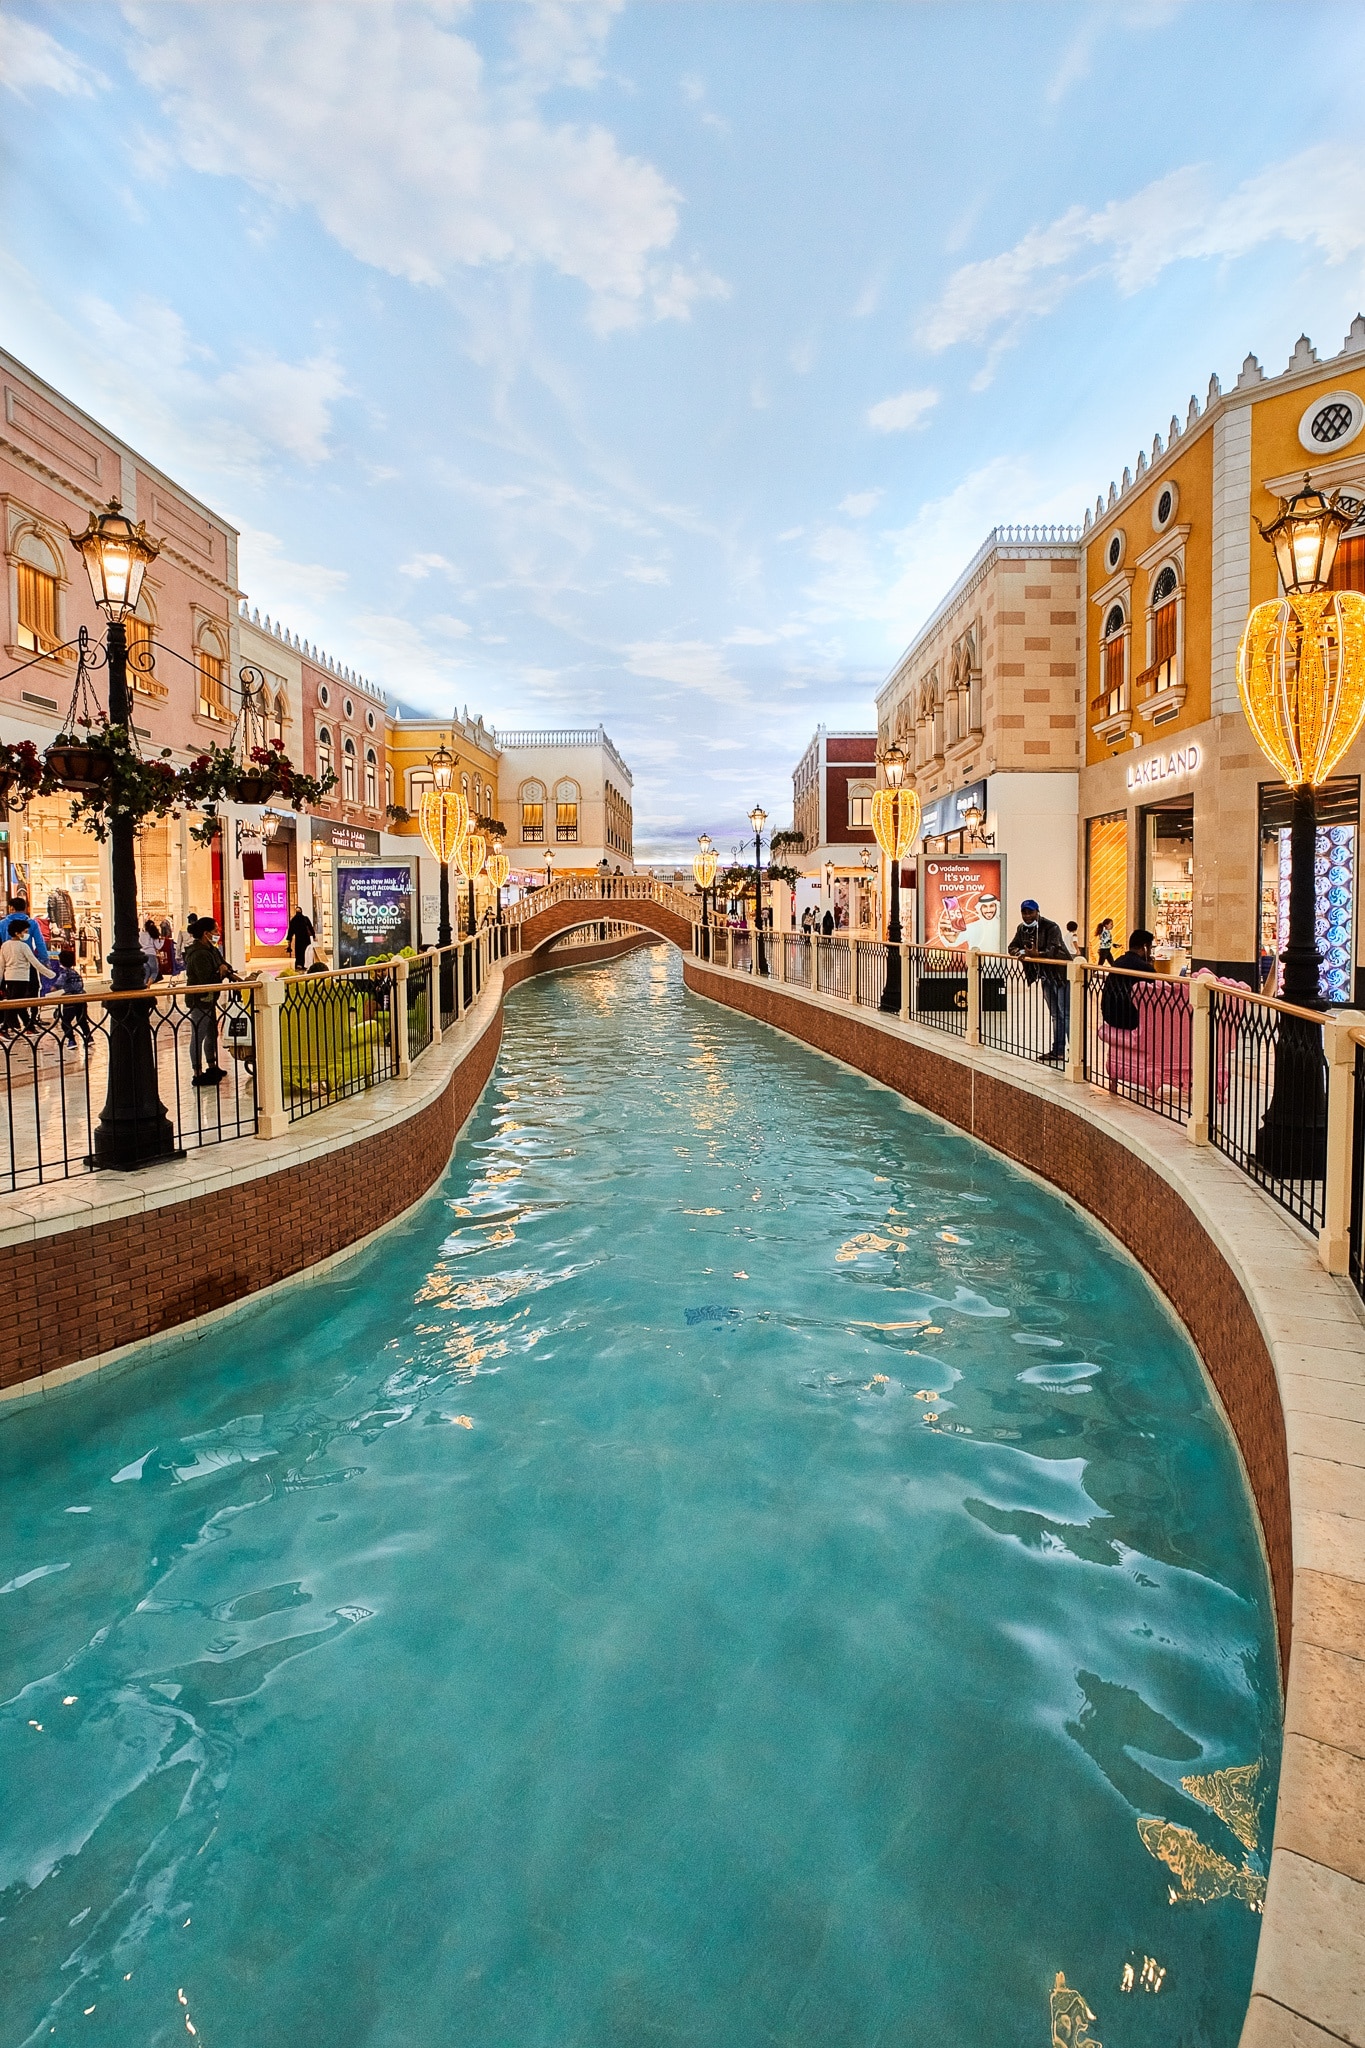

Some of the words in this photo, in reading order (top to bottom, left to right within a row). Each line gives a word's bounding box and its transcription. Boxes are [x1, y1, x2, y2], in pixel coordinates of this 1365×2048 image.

[1126, 746, 1200, 789] LAKELAND
[332, 837, 349, 847] CHARLES
[350, 840, 354, 848] &
[351, 878, 366, 886] Open
[944, 873, 959, 882] It's
[959, 874, 981, 884] your
[356, 884, 377, 892] Deposit
[939, 884, 966, 892] move
[966, 884, 985, 892] now
[256, 892, 284, 904] SALE
[349, 898, 399, 918] 18,000
[348, 915, 376, 925] Absher
[377, 915, 402, 925] Points
[949, 909, 963, 920] 5G
